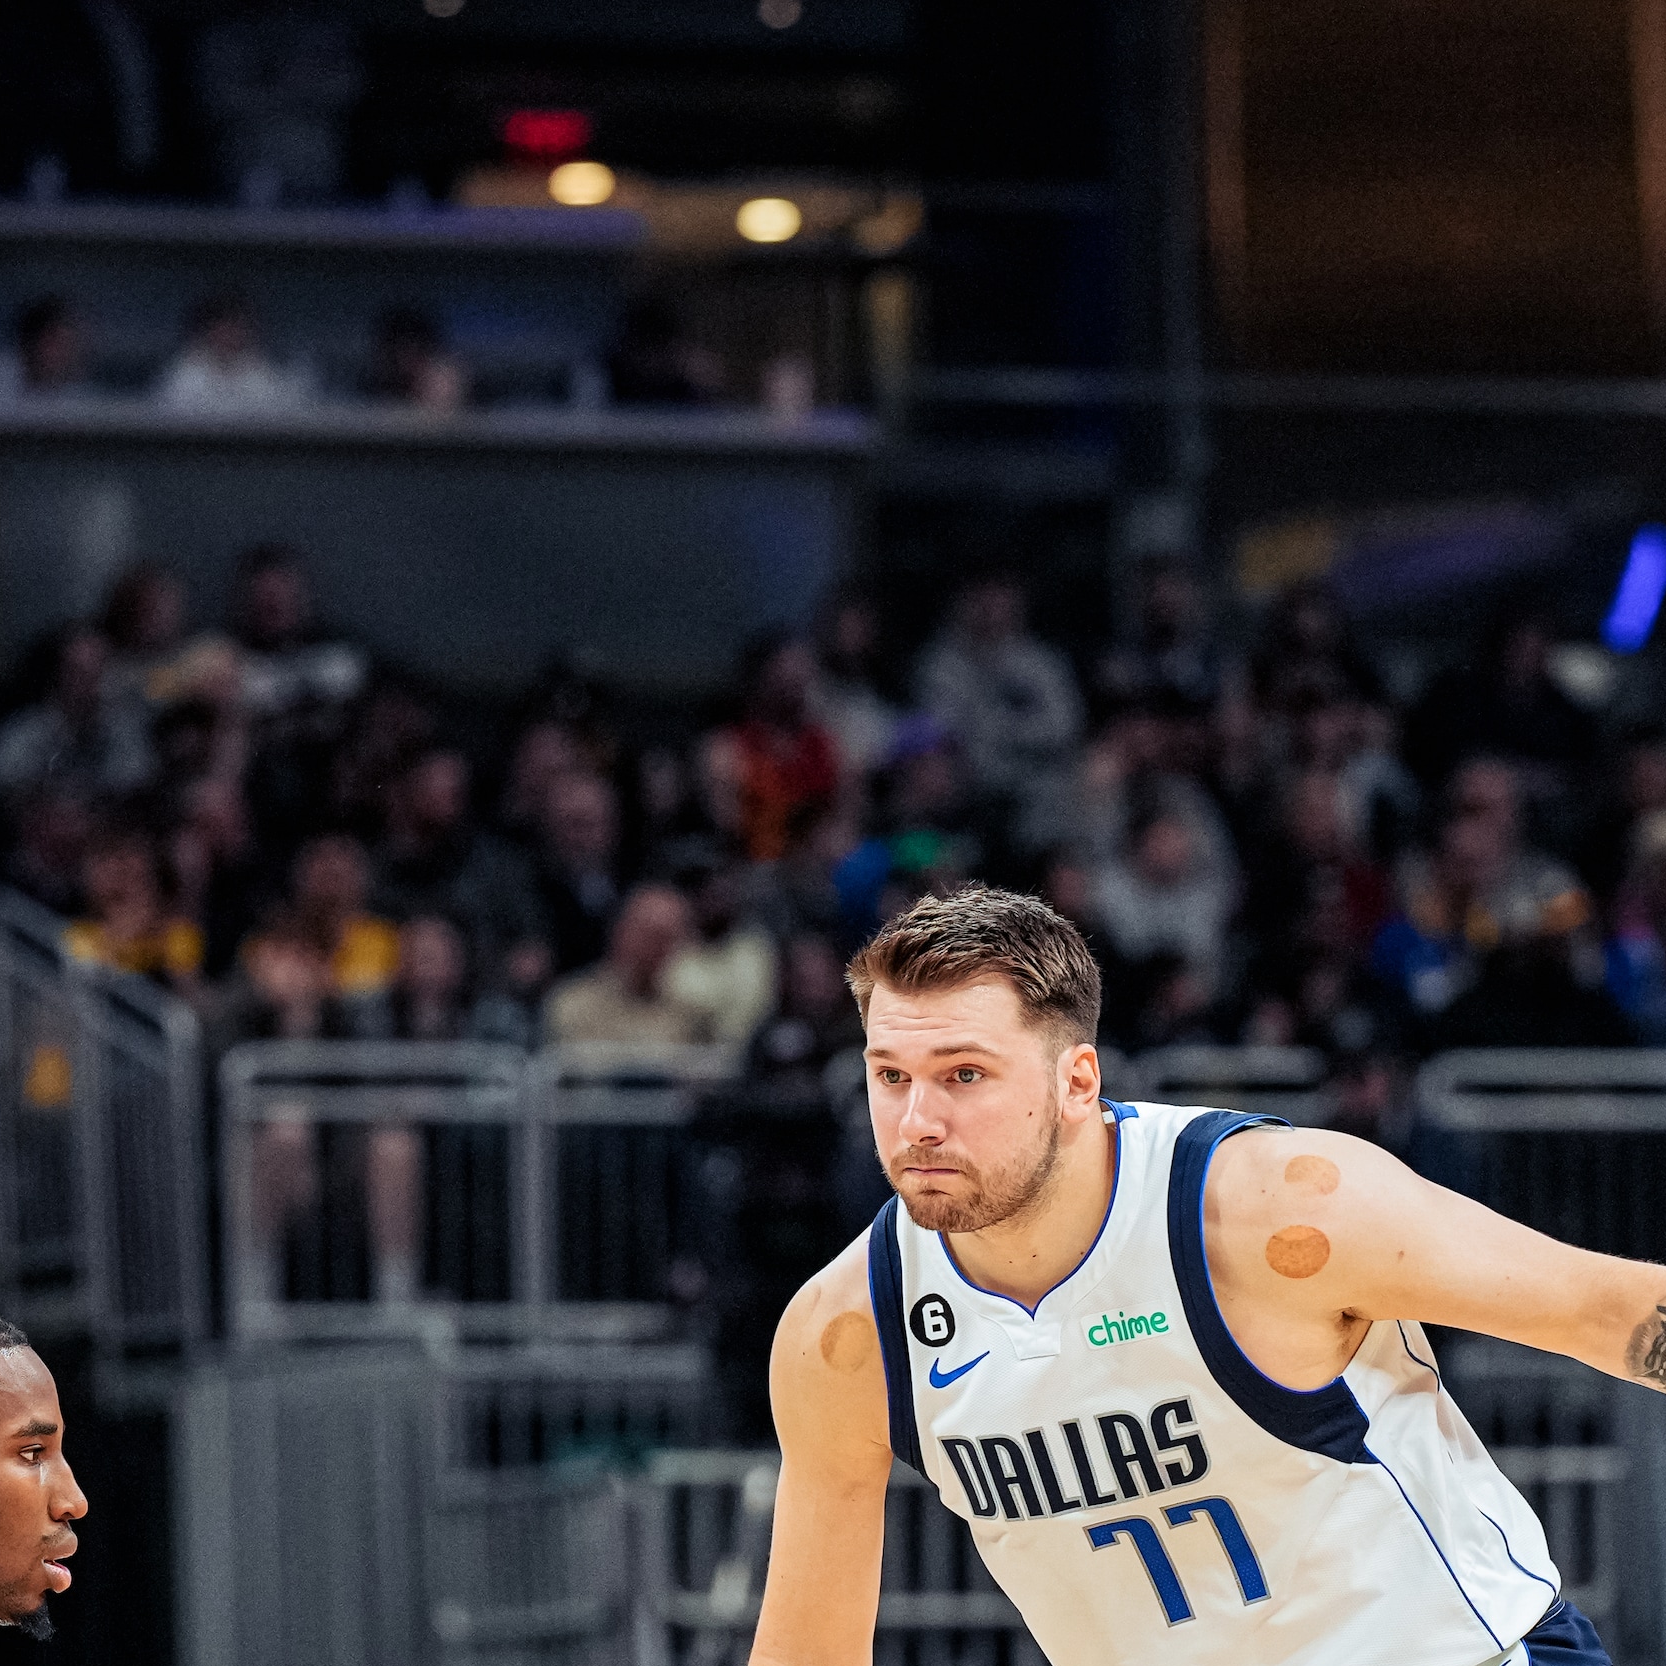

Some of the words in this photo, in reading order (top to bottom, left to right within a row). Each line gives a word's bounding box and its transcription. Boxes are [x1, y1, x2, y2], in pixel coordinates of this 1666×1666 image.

[921, 1300, 949, 1341] 6
[1087, 1311, 1170, 1347] chime
[937, 1395, 1212, 1522] DALLAS
[1082, 1494, 1272, 1628] 77
